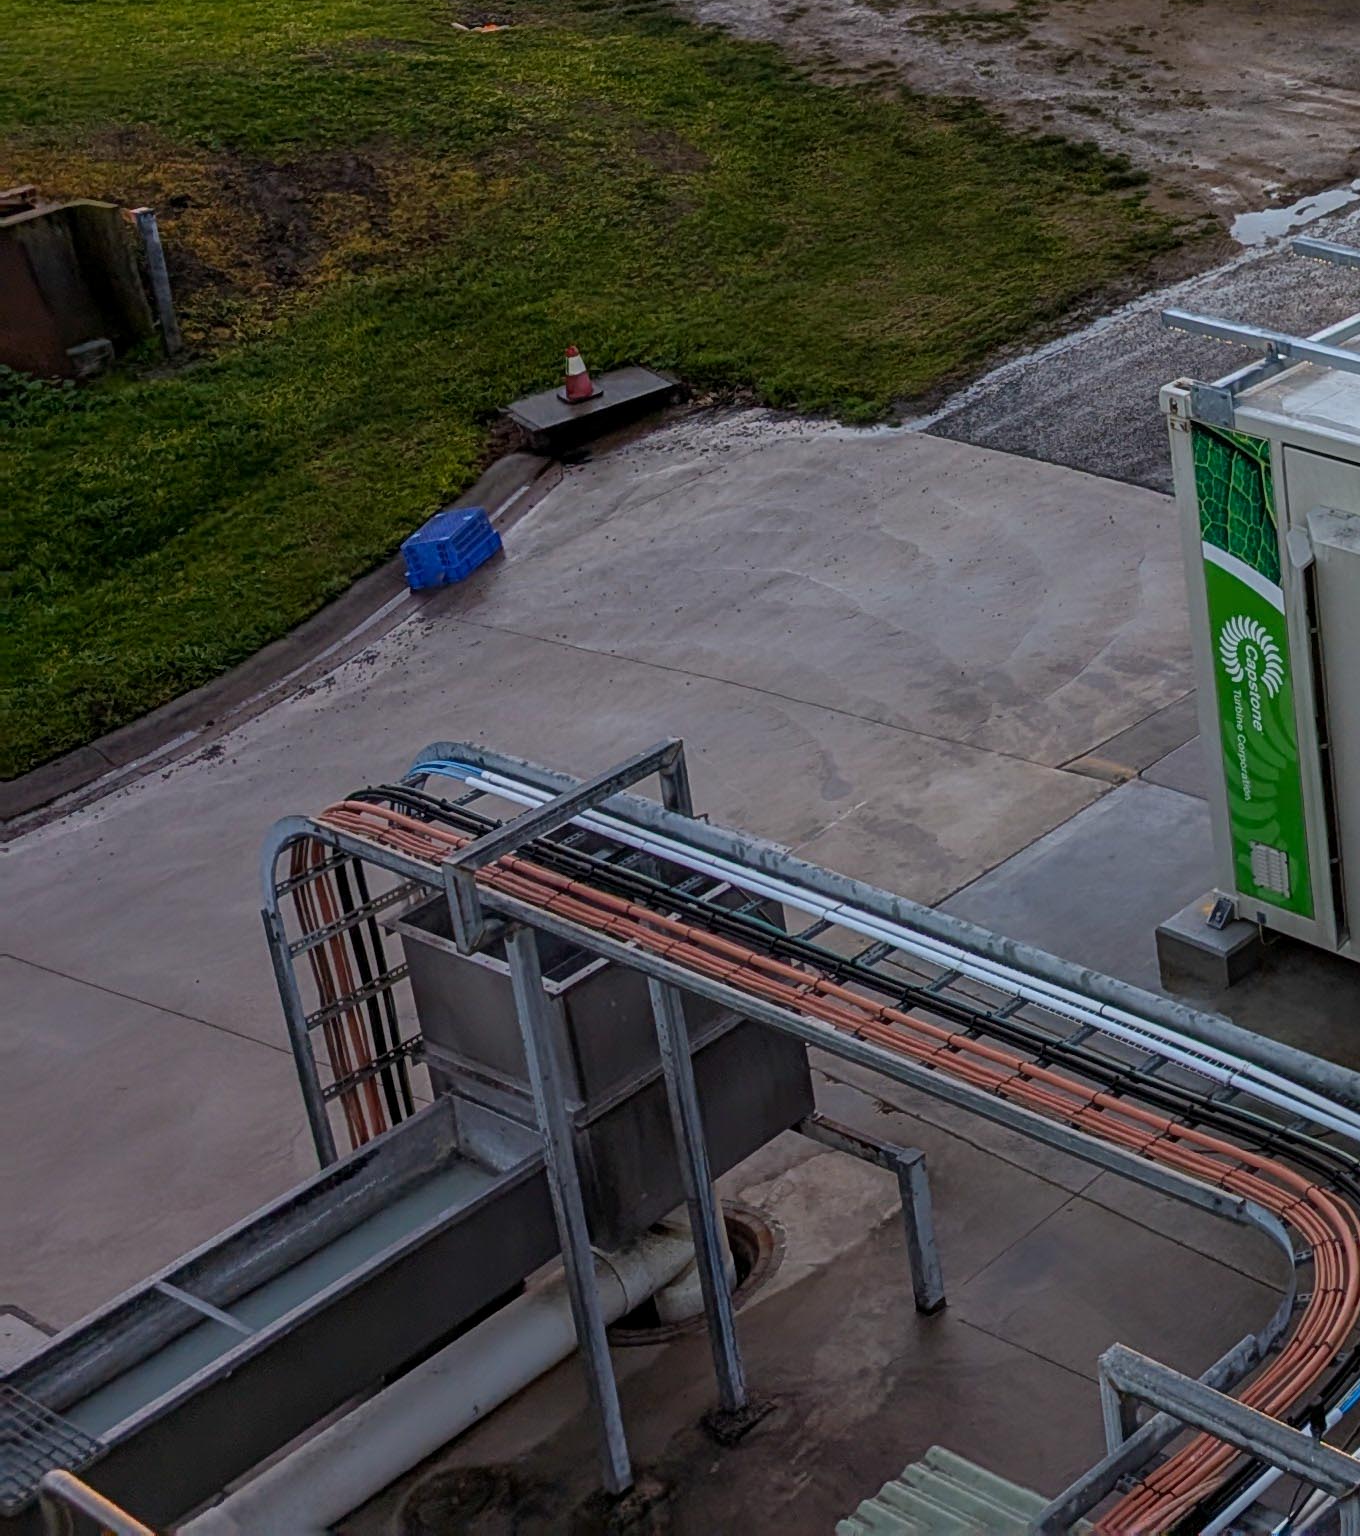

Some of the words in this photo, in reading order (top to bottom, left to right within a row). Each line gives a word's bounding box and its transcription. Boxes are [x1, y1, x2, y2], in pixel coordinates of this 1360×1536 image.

[1232, 690, 1243, 732] Turbine
[1244, 644, 1263, 732] Capstone
[1237, 734, 1252, 801] Corporation
